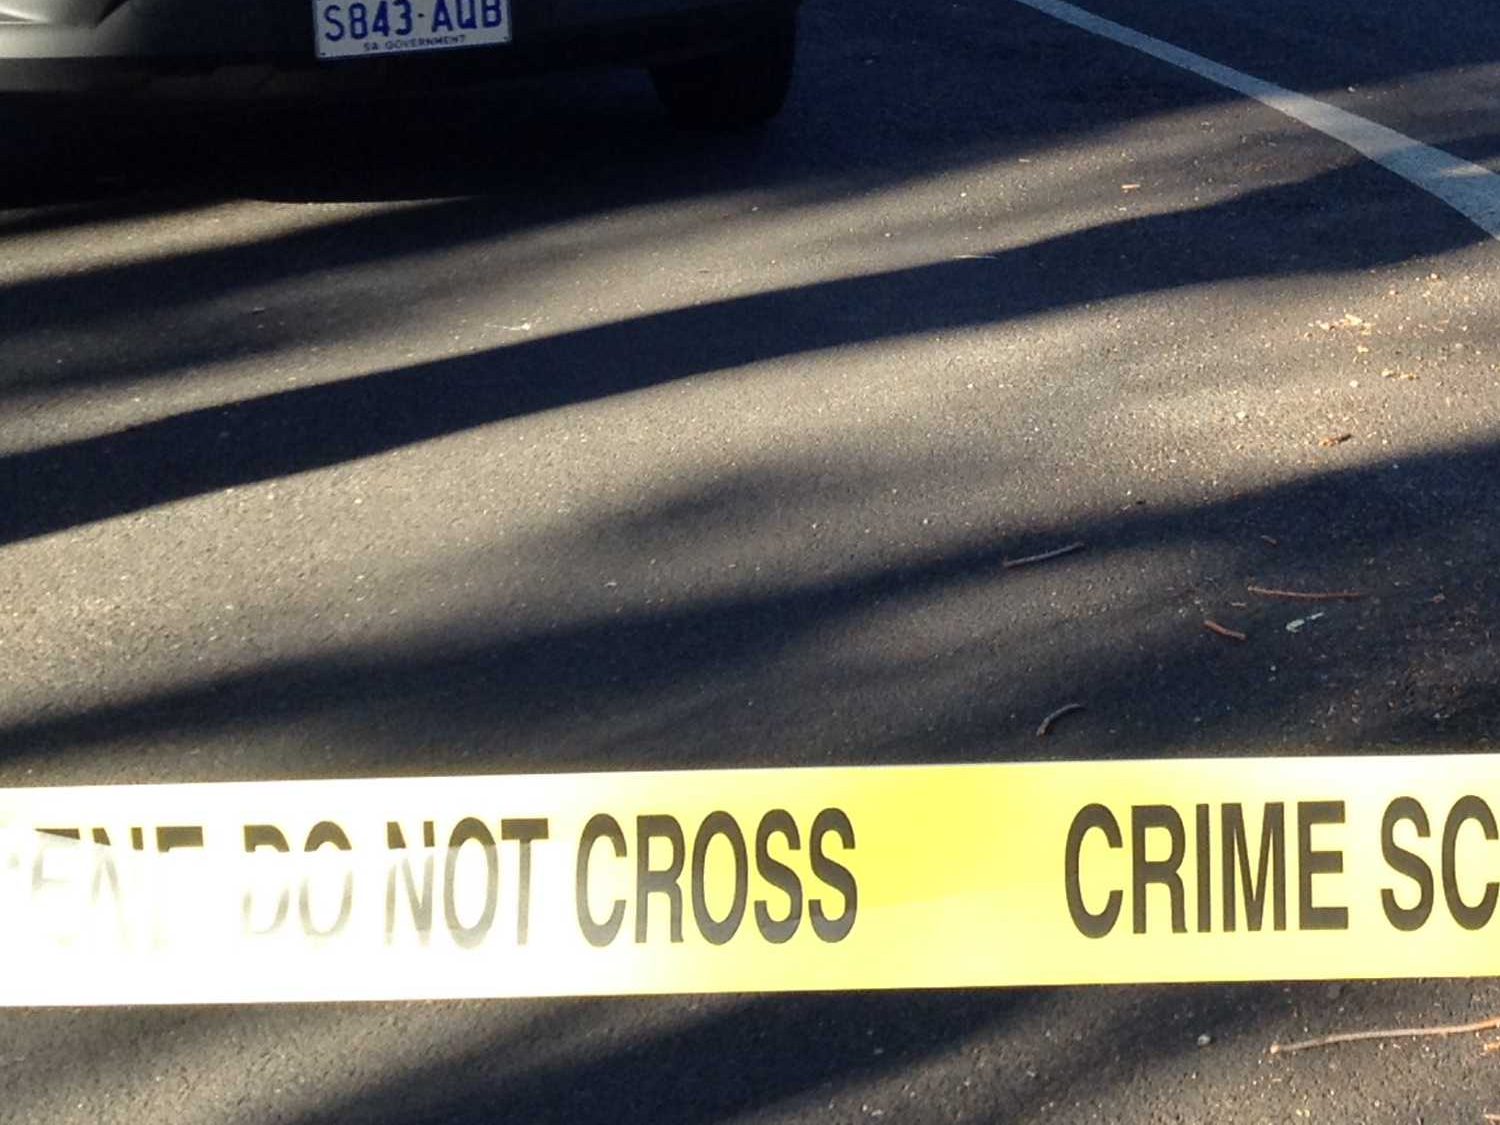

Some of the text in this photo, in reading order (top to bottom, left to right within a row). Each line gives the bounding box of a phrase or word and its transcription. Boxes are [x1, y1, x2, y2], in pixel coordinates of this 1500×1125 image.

[387, 34, 466, 50] GOVERNMENT
[243, 820, 352, 946] DO
[386, 816, 549, 947] NOT
[576, 807, 858, 946] CROSS
[1064, 801, 1349, 939] CRIME
